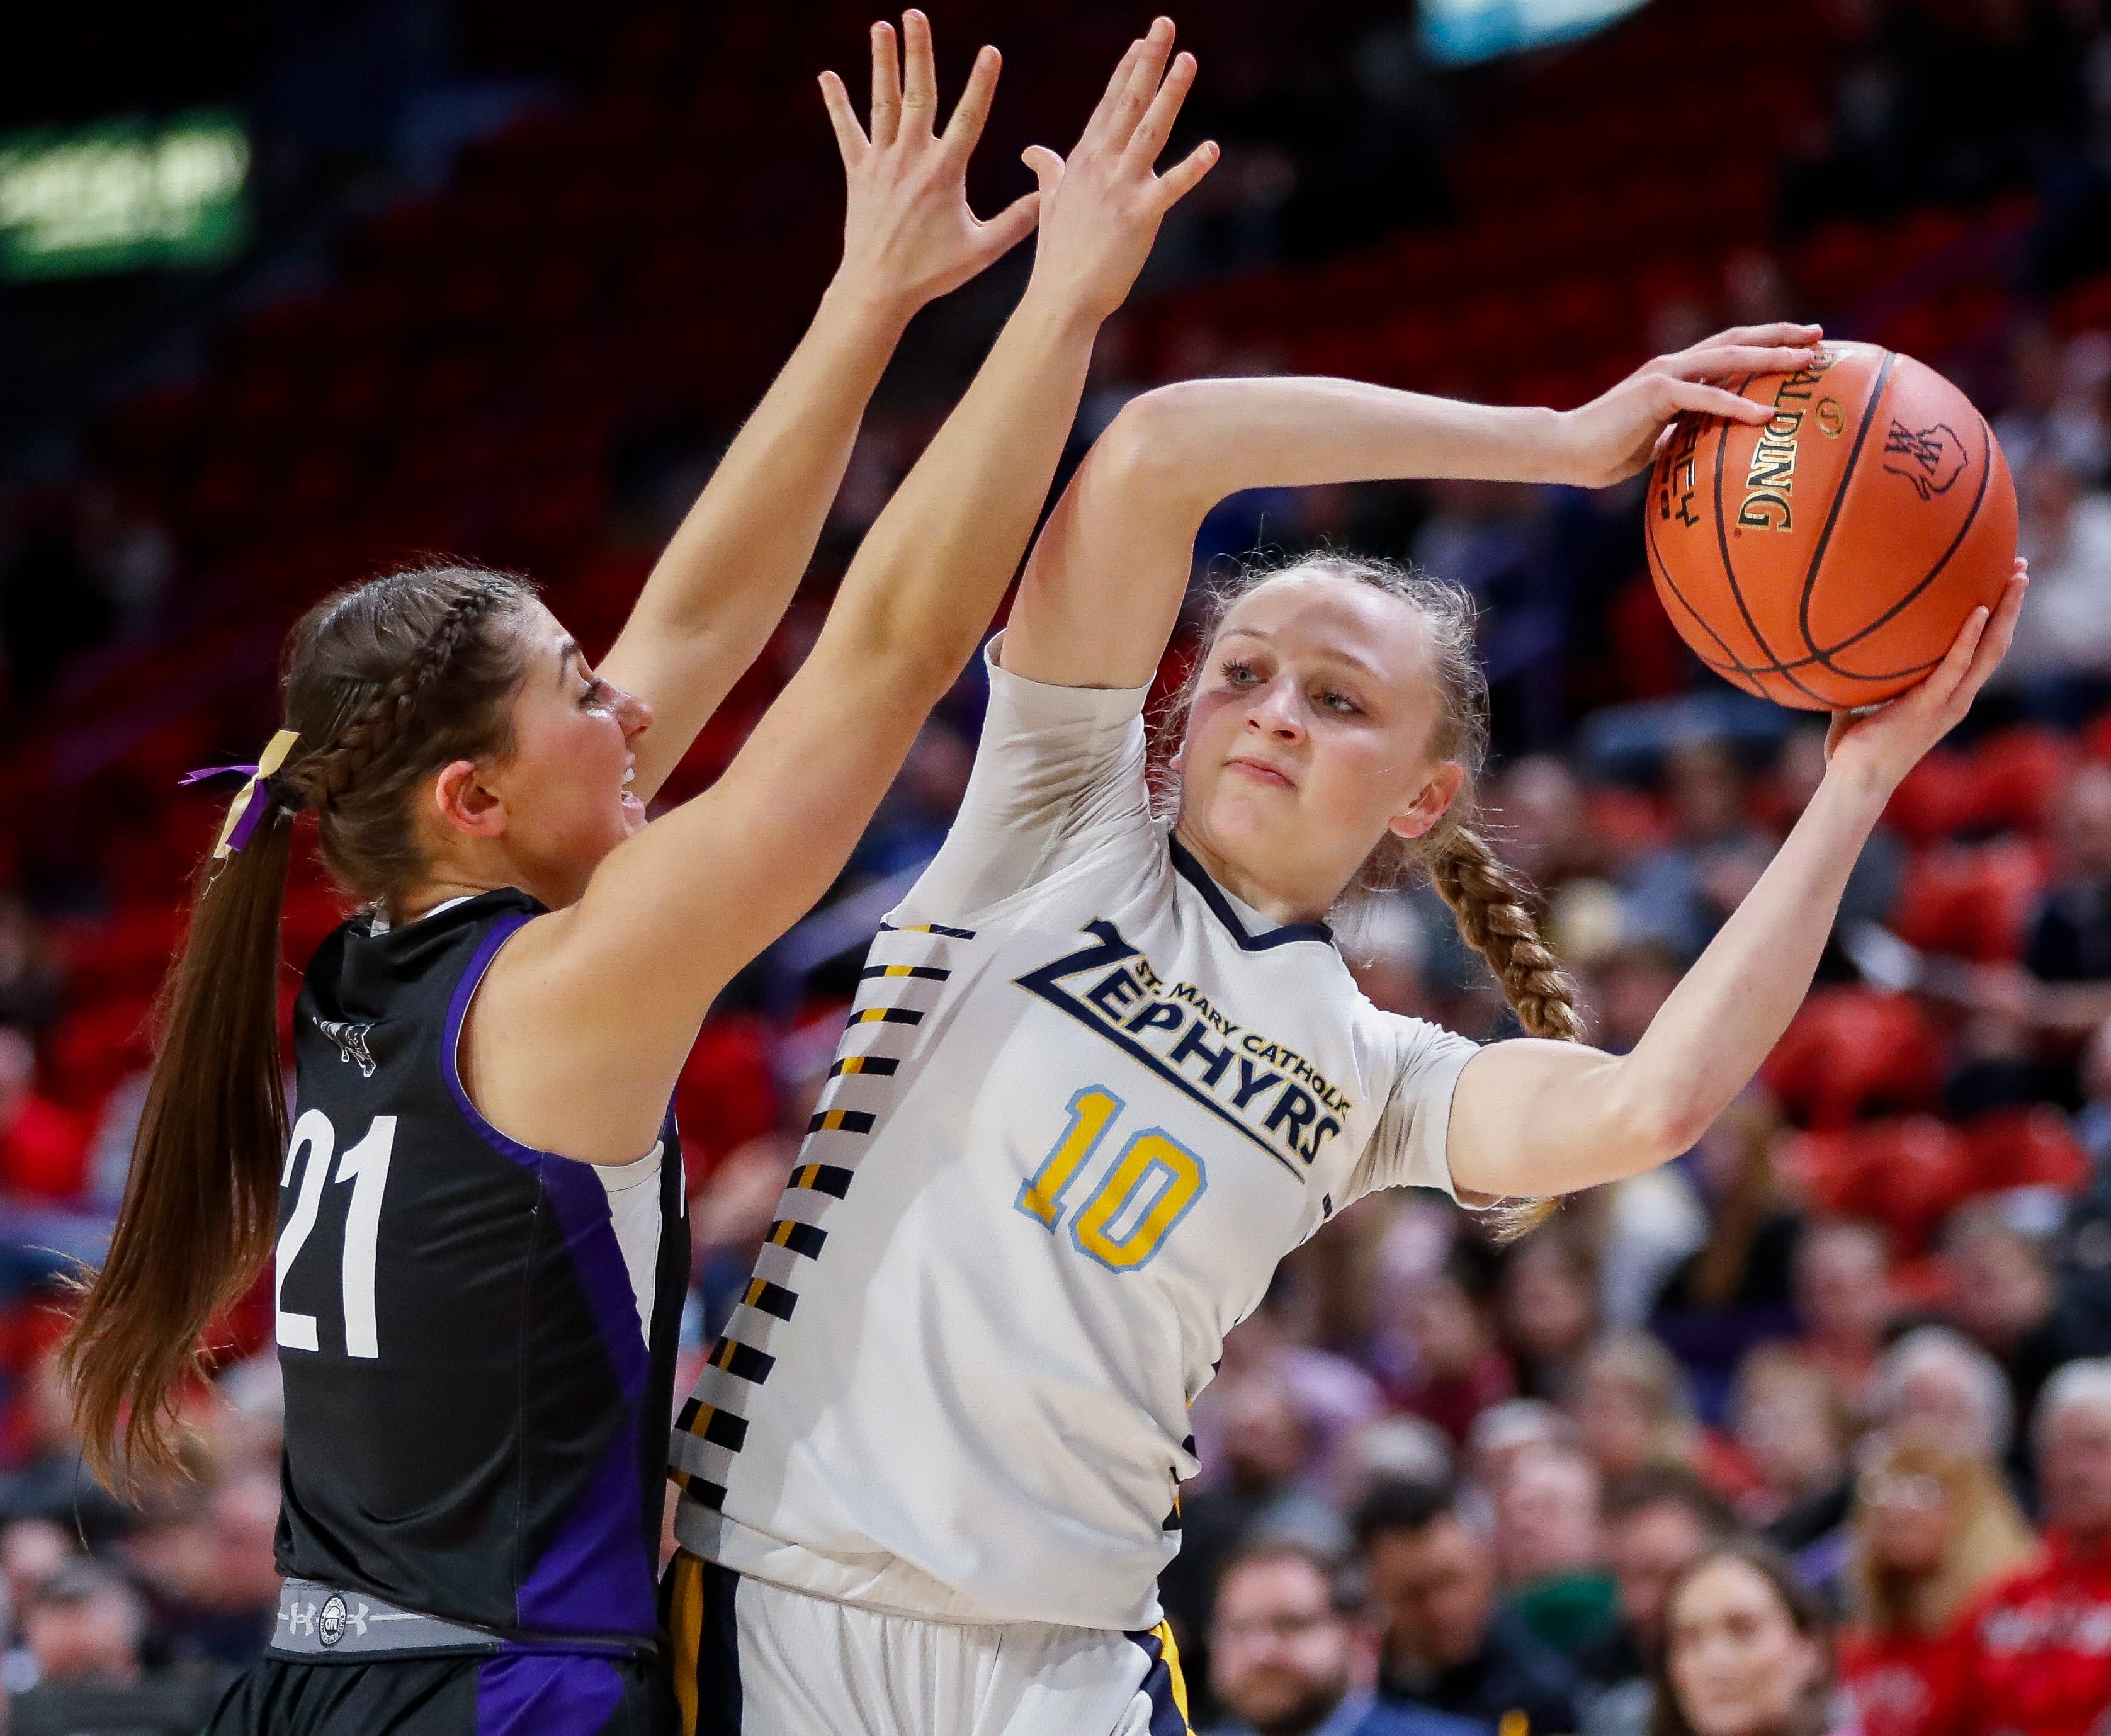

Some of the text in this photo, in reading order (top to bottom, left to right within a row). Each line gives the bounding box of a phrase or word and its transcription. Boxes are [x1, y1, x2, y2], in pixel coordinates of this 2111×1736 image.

[1010, 916, 1342, 1171] ZEPHYRS
[1135, 959, 1165, 997] ST.
[1166, 980, 1242, 1038] MARY
[275, 1109, 397, 1358] 21
[1014, 1084, 1208, 1274] 10
